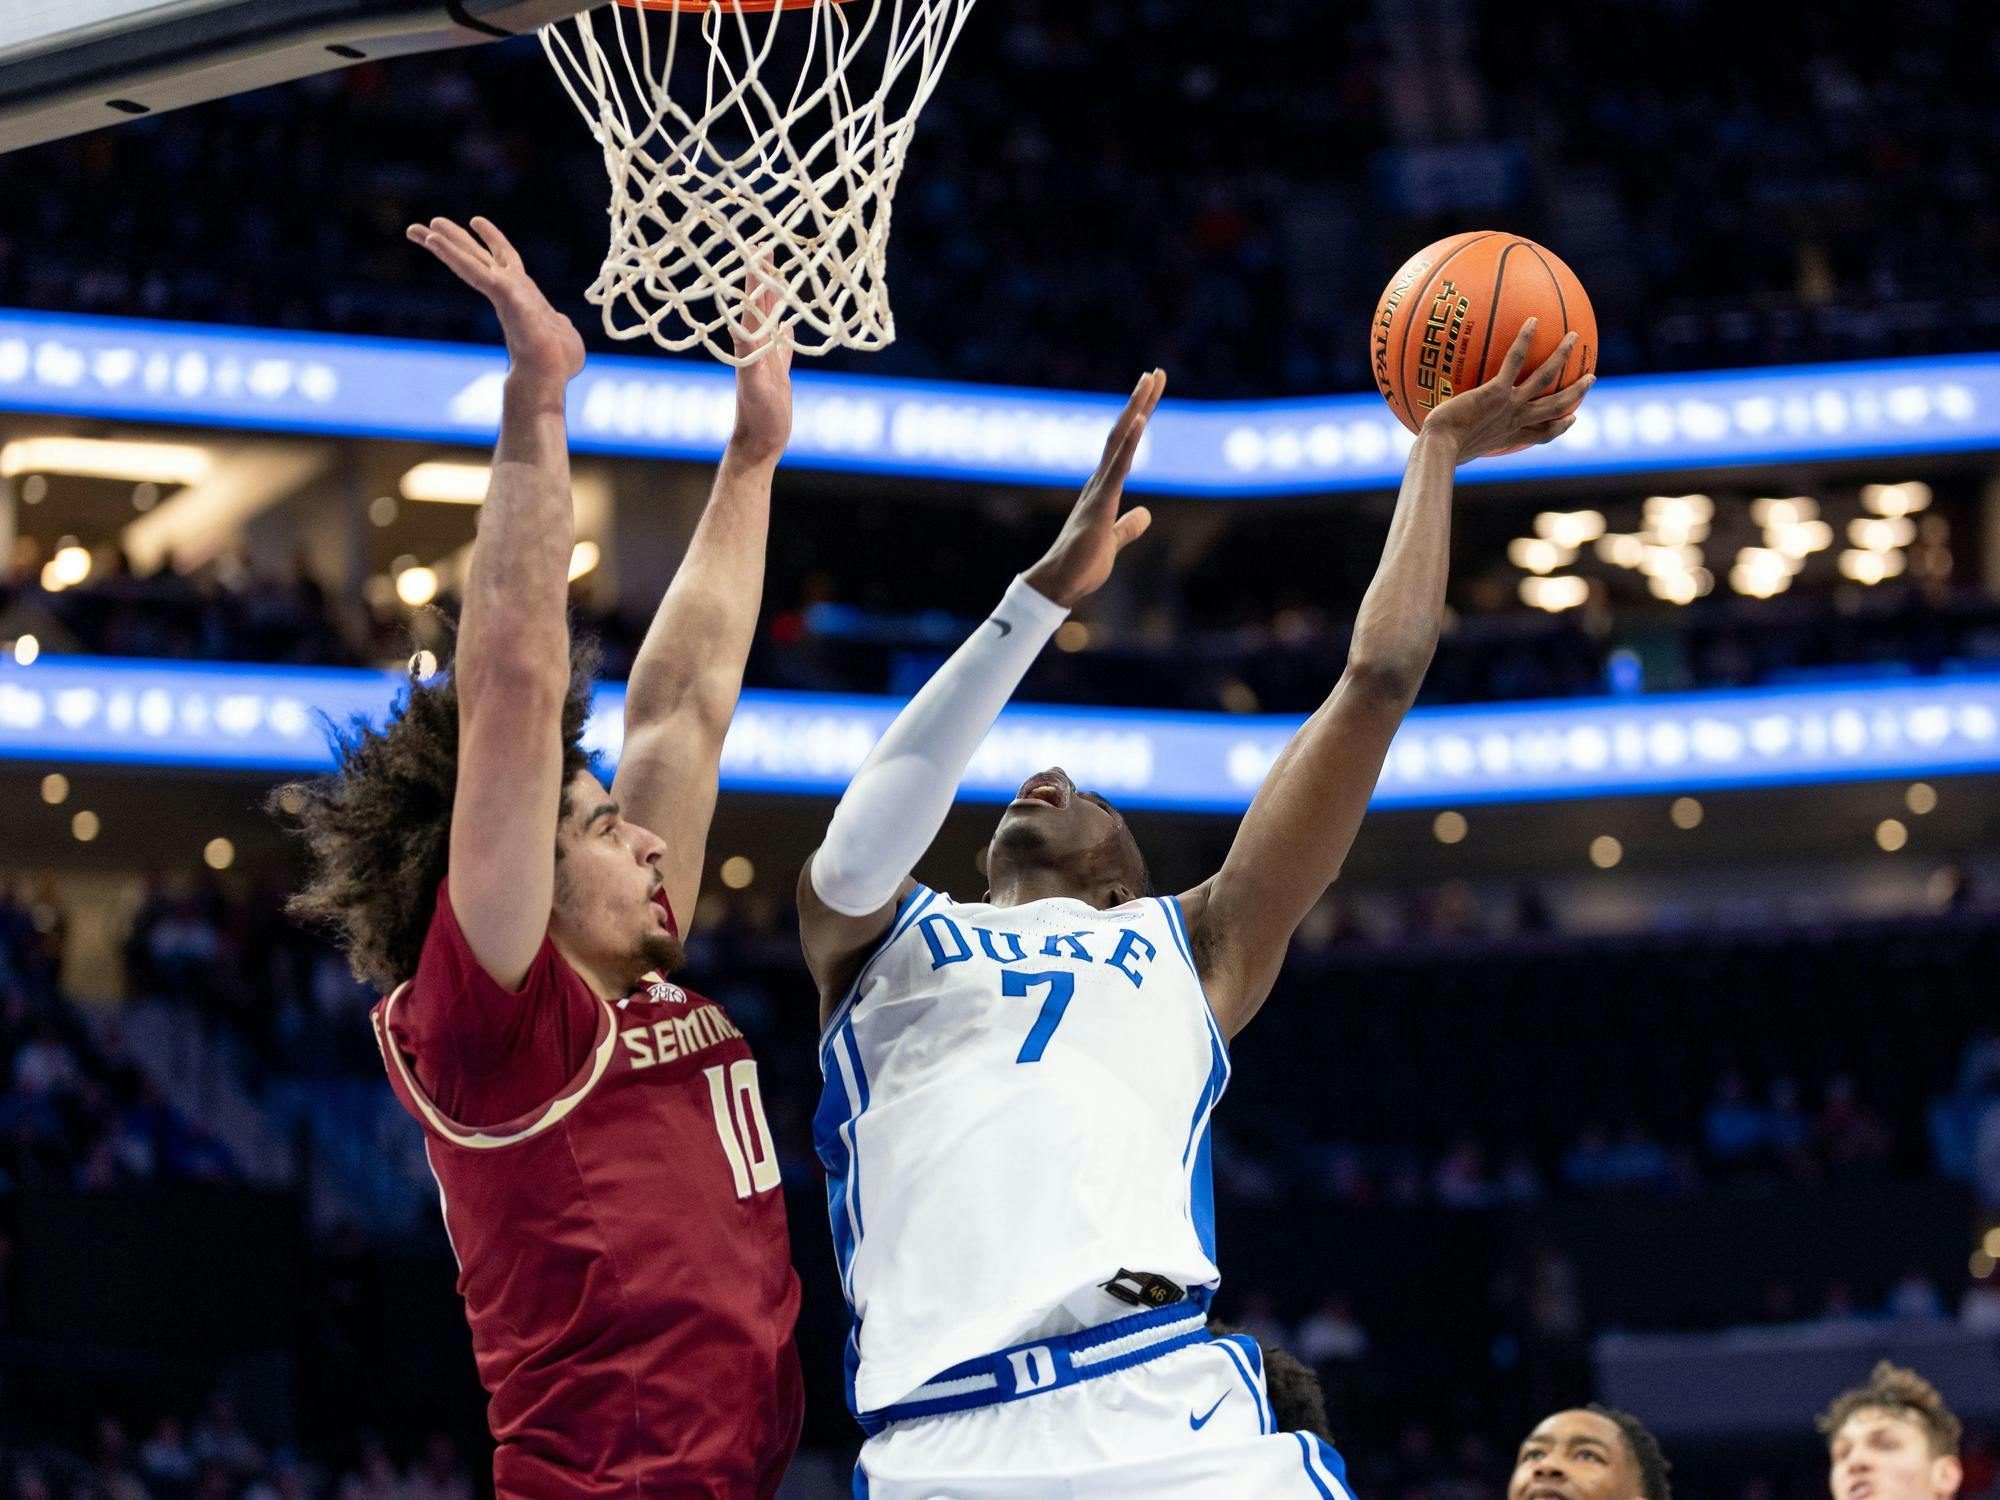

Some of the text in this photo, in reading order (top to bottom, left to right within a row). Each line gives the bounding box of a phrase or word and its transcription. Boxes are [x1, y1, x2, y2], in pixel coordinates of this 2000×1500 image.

[1376, 259, 1431, 406] SPALDING
[1416, 280, 1459, 411] LEGACY
[1441, 296, 1470, 375] 1000
[1454, 355, 1465, 386] OFFICIAL
[1460, 336, 1469, 355] GAME
[915, 913, 1157, 989] DUKE
[620, 1003, 744, 1070] SEMIN
[1001, 969, 1075, 1064] 7
[703, 1059, 782, 1199] 10
[1149, 1285, 1167, 1302] 46
